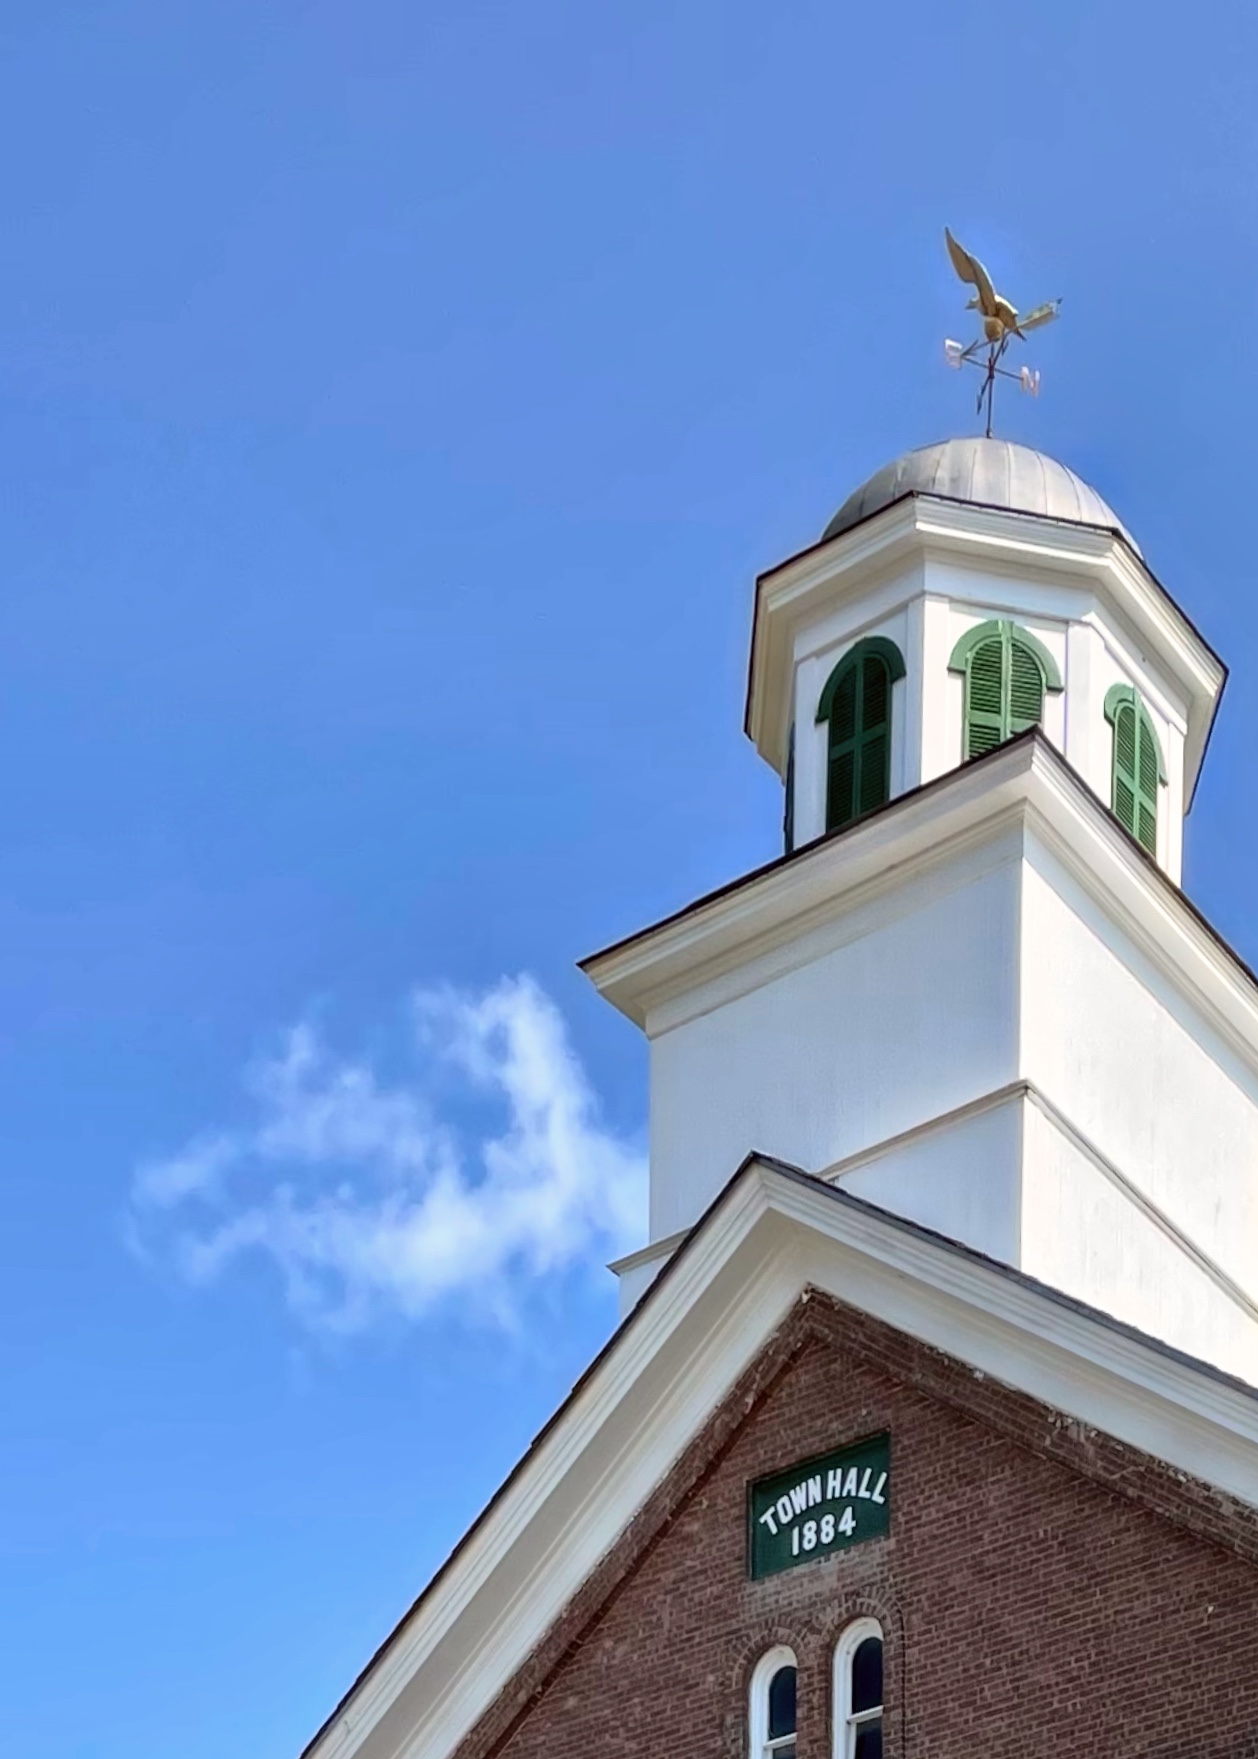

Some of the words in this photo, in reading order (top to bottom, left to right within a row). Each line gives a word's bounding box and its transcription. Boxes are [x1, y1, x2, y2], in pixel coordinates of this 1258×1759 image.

[759, 1475, 822, 1535] TOWN
[826, 1467, 888, 1504] HALL
[791, 1506, 856, 1556] 1884
